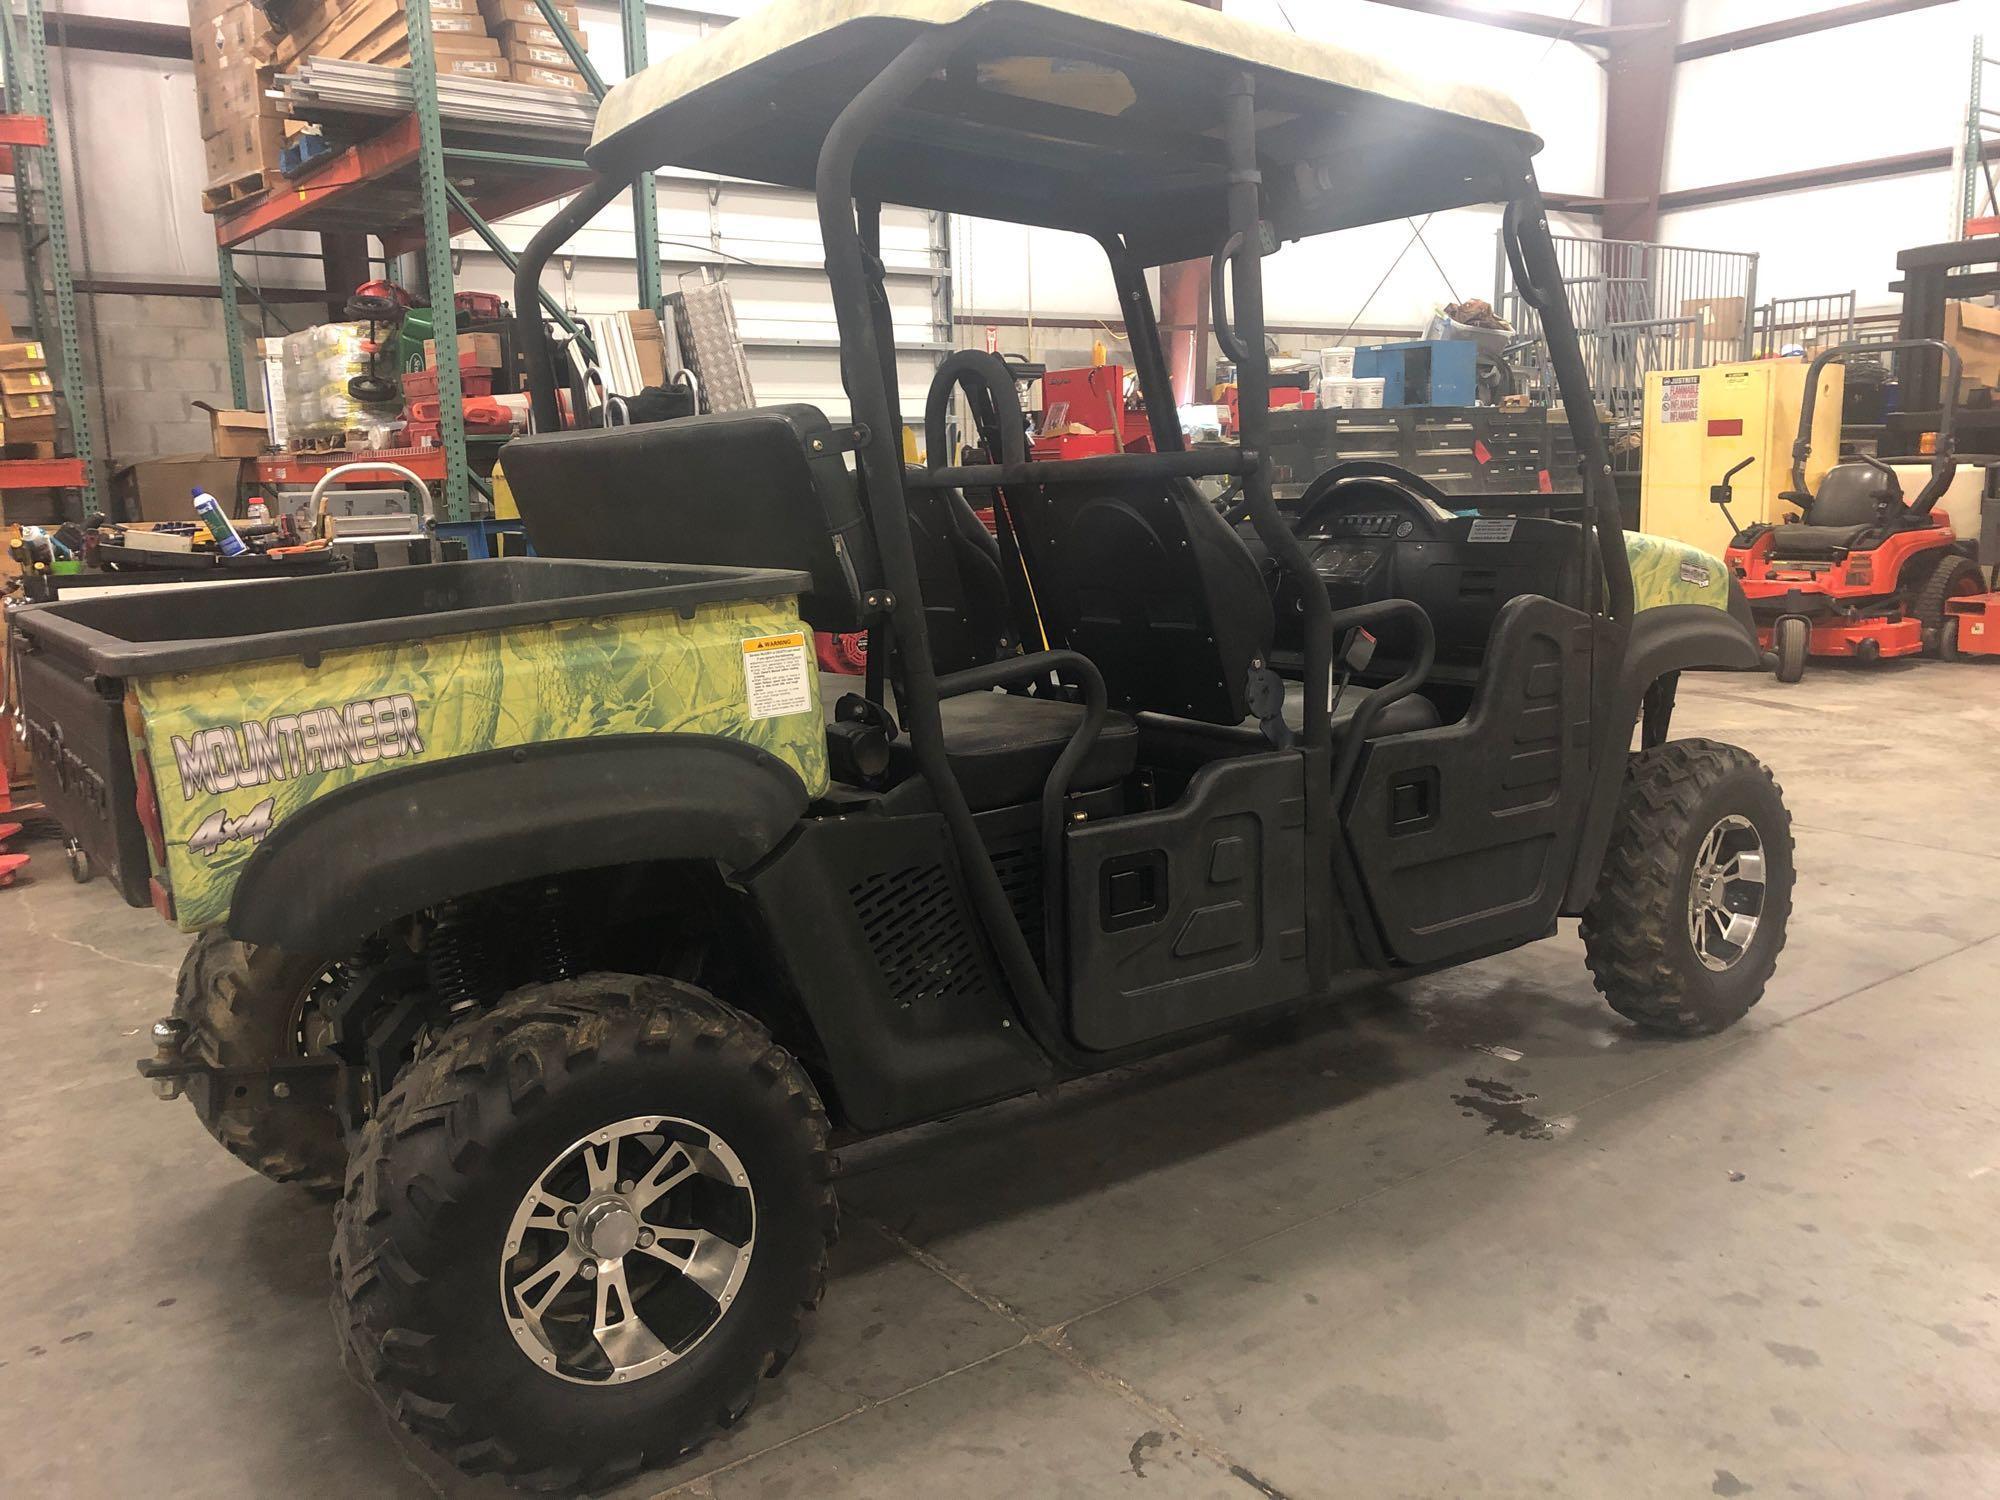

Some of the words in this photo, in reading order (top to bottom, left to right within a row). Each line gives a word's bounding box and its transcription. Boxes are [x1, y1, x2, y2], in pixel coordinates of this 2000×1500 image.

[1670, 384, 1699, 394] FLAMMABLE
[764, 639, 791, 648] WARNING
[170, 693, 425, 800] MOUNTAINEER
[186, 797, 275, 857] 4x4
